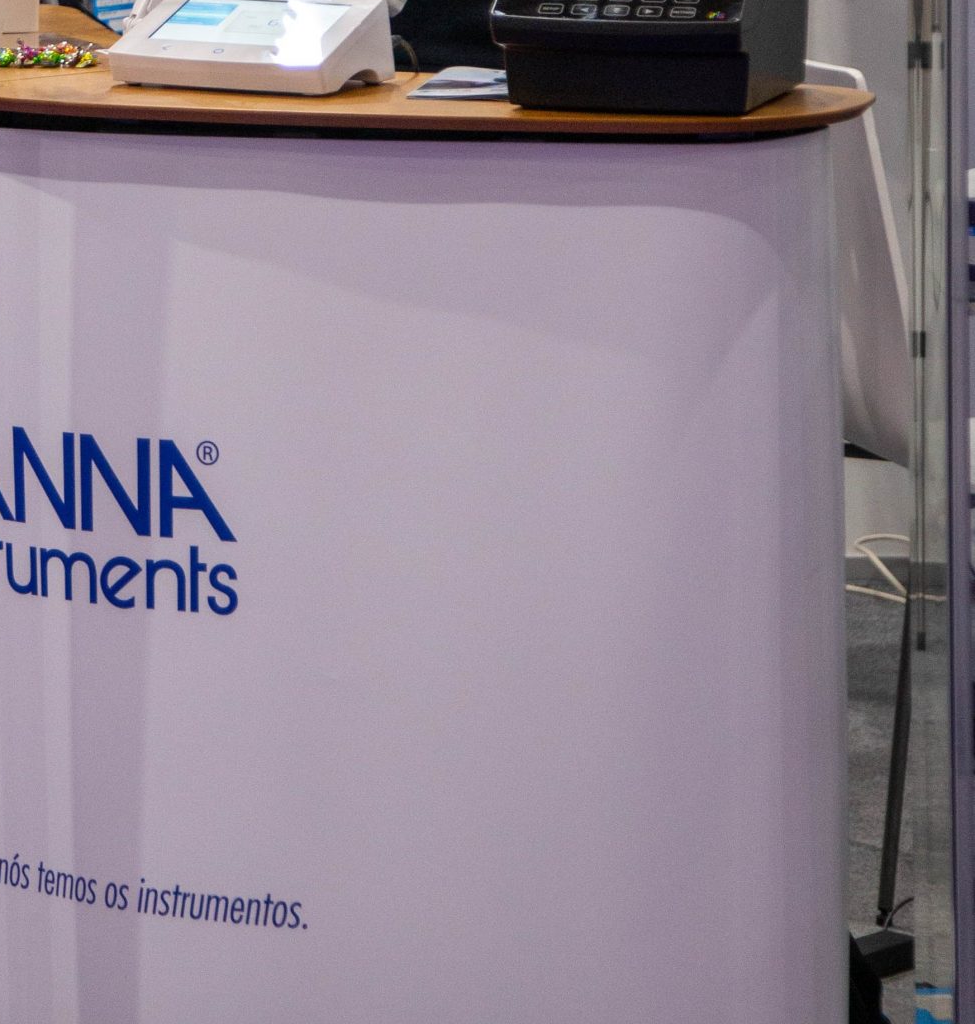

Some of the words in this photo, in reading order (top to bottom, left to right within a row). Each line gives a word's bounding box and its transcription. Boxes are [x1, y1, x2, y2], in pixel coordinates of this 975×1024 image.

[37, 861, 98, 905] temos
[105, 882, 130, 911] os
[137, 877, 309, 930] instrumentos.
